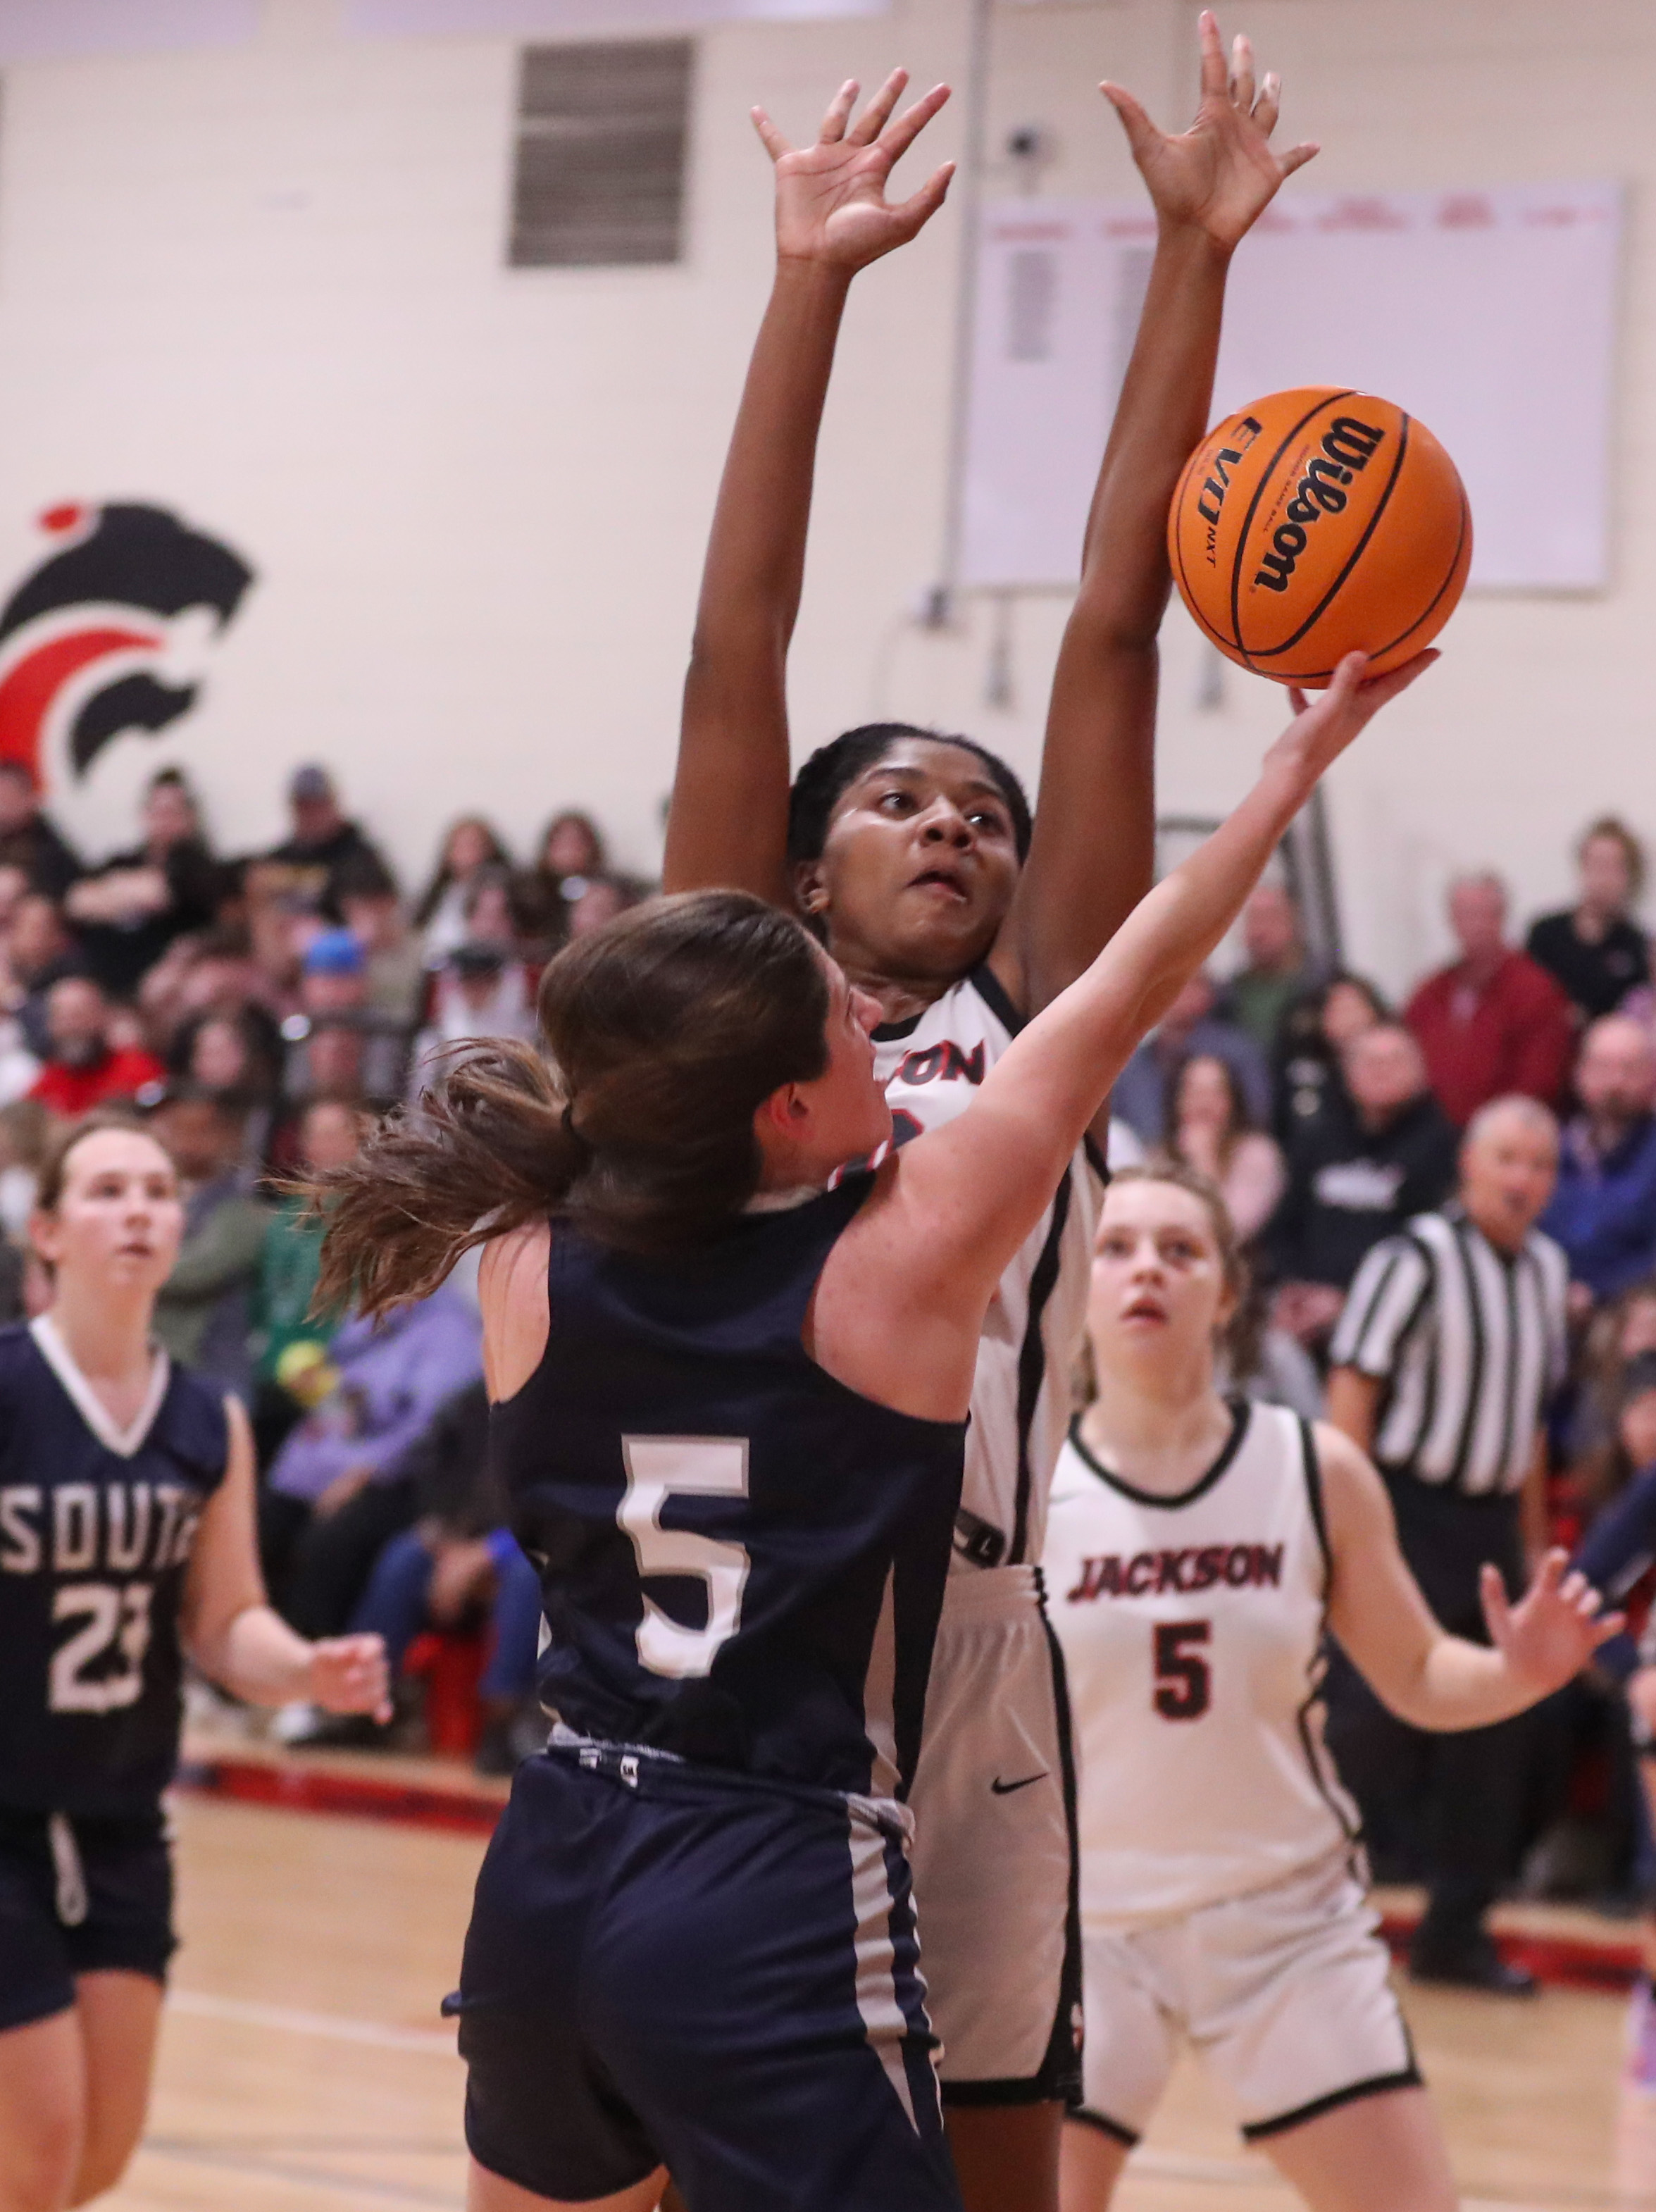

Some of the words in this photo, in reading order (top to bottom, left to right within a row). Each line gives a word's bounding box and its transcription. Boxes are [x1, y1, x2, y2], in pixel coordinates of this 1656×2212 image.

[1198, 416, 1263, 526] EVO
[1253, 415, 1386, 593] Wilson
[1276, 480, 1292, 507] GAME
[1206, 526, 1216, 568] NXT
[1262, 509, 1277, 533] BALL
[616, 1434, 751, 1679] 5
[1067, 1543, 1284, 1603] JACKSON
[1152, 1620, 1213, 1722] 5
